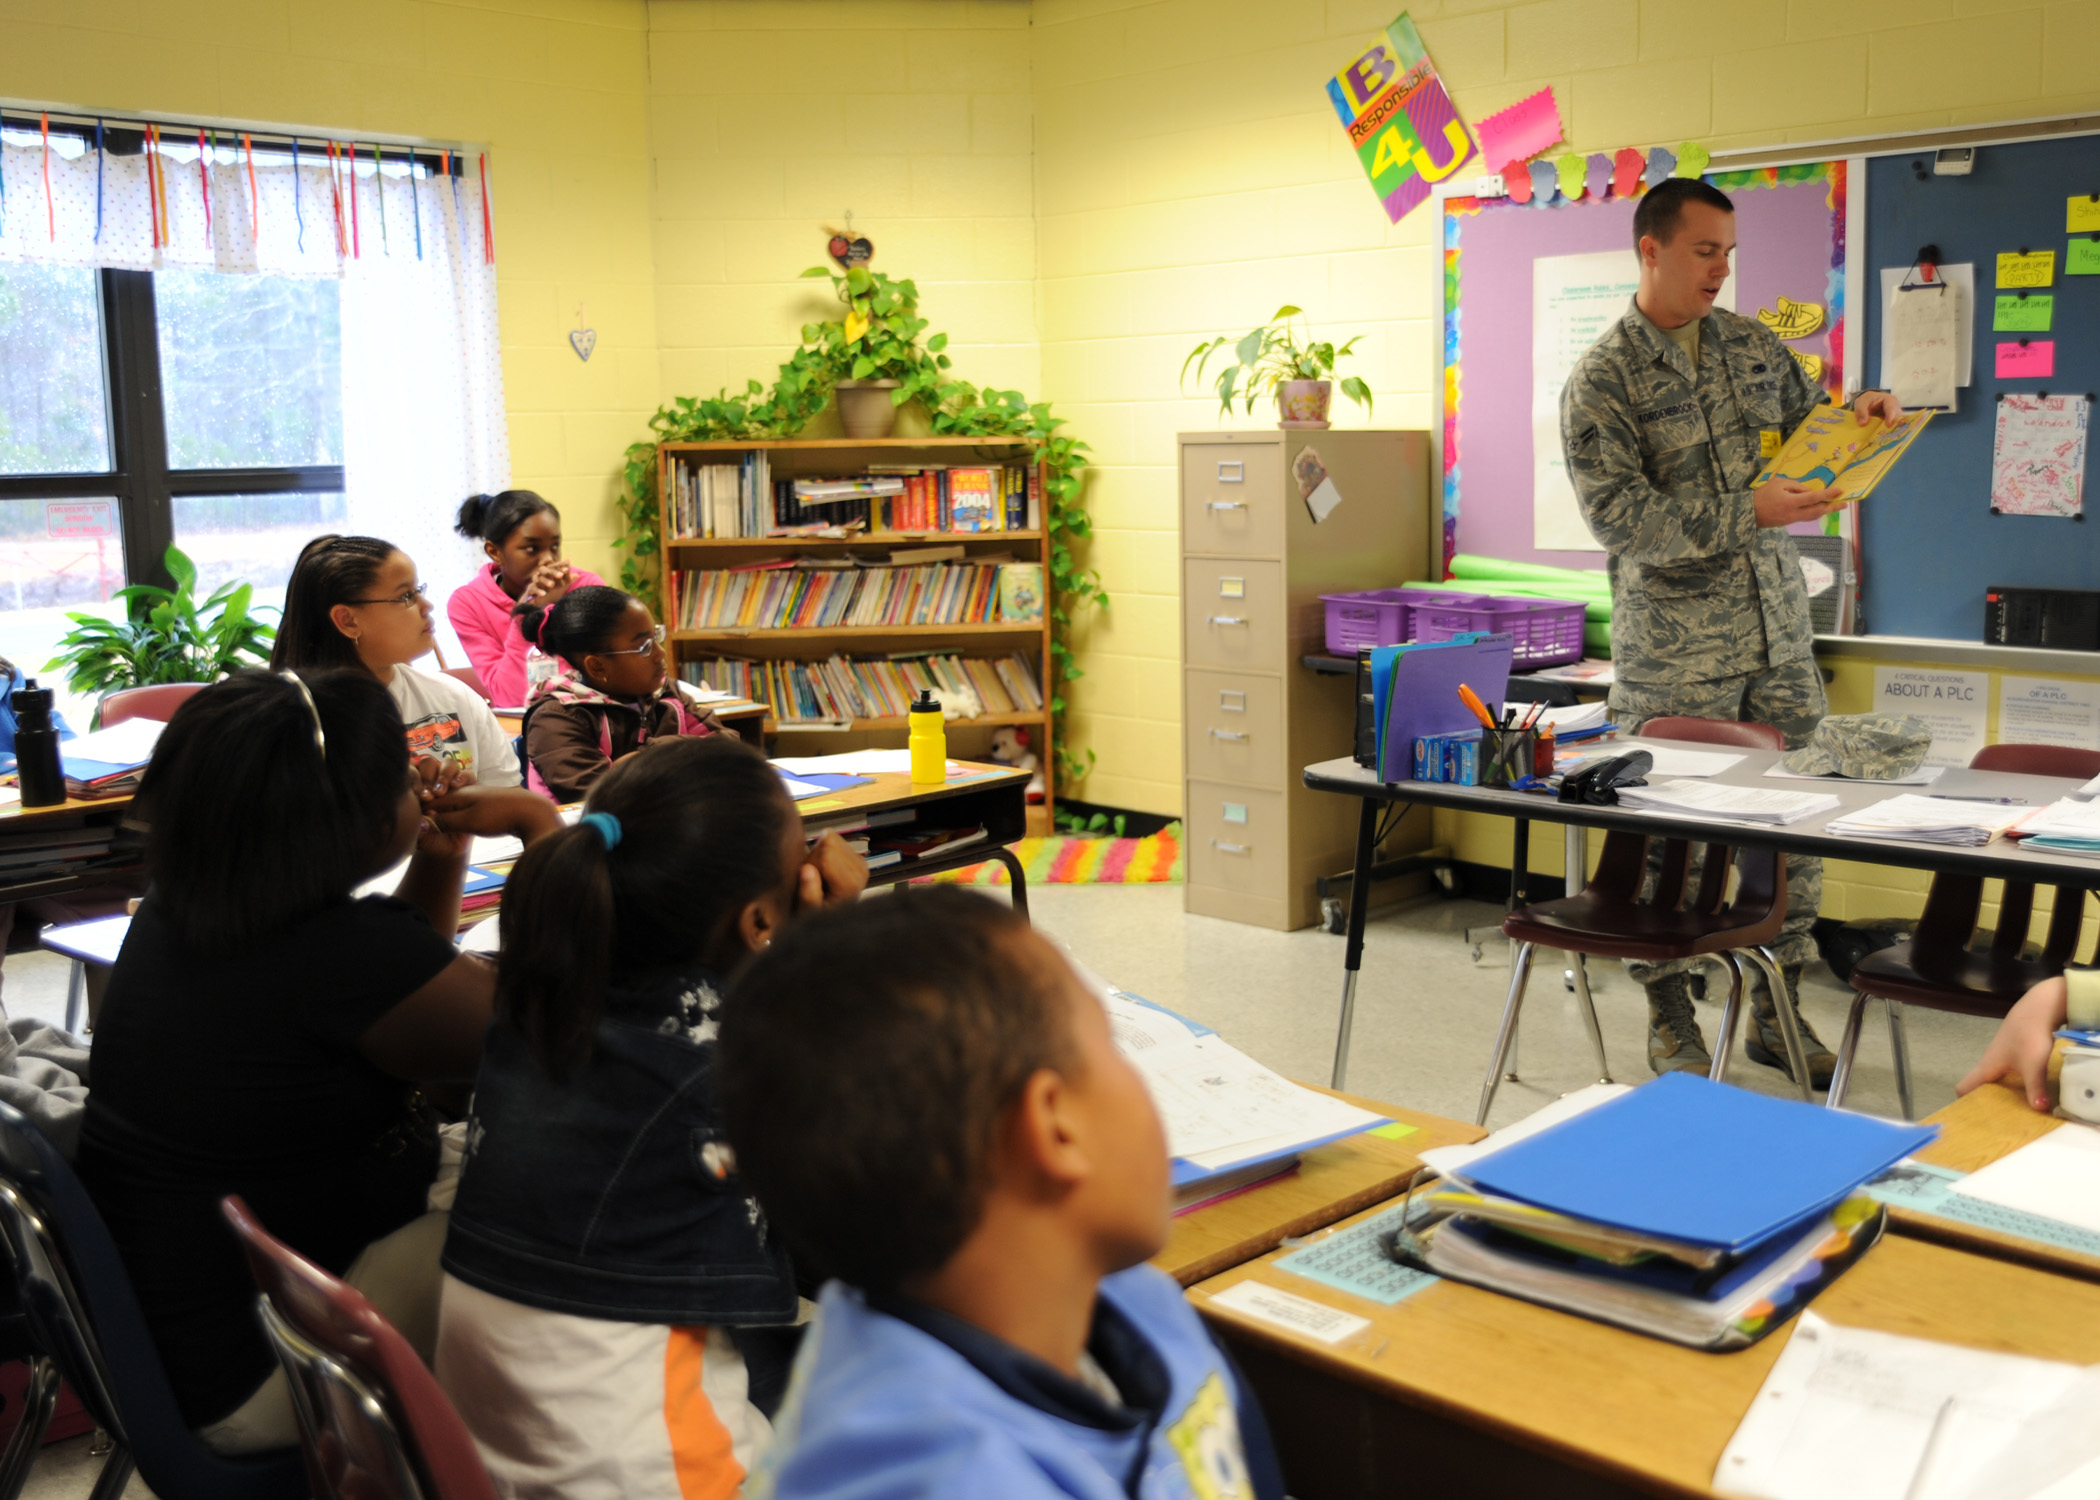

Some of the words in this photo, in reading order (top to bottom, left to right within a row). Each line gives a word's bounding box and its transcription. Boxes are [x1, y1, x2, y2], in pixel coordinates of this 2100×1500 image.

[1345, 46, 1396, 107] B
[1350, 62, 1433, 143] Responsible
[1492, 110, 1528, 135] Class
[1371, 125, 1413, 179] 4
[1410, 118, 1469, 182] U
[2010, 272, 2040, 283] PARTY
[1638, 402, 1694, 425] KORDENBROCK
[954, 493, 991, 509] 2004
[1928, 675, 1964, 684] QUESTIONS
[1884, 683, 1930, 698] ABOUT
[1934, 686, 1943, 698] A
[1947, 686, 1974, 701] PLC
[2029, 690, 2040, 698] OF
[2042, 691, 2049, 699] A
[2050, 692, 2067, 700] PLC
